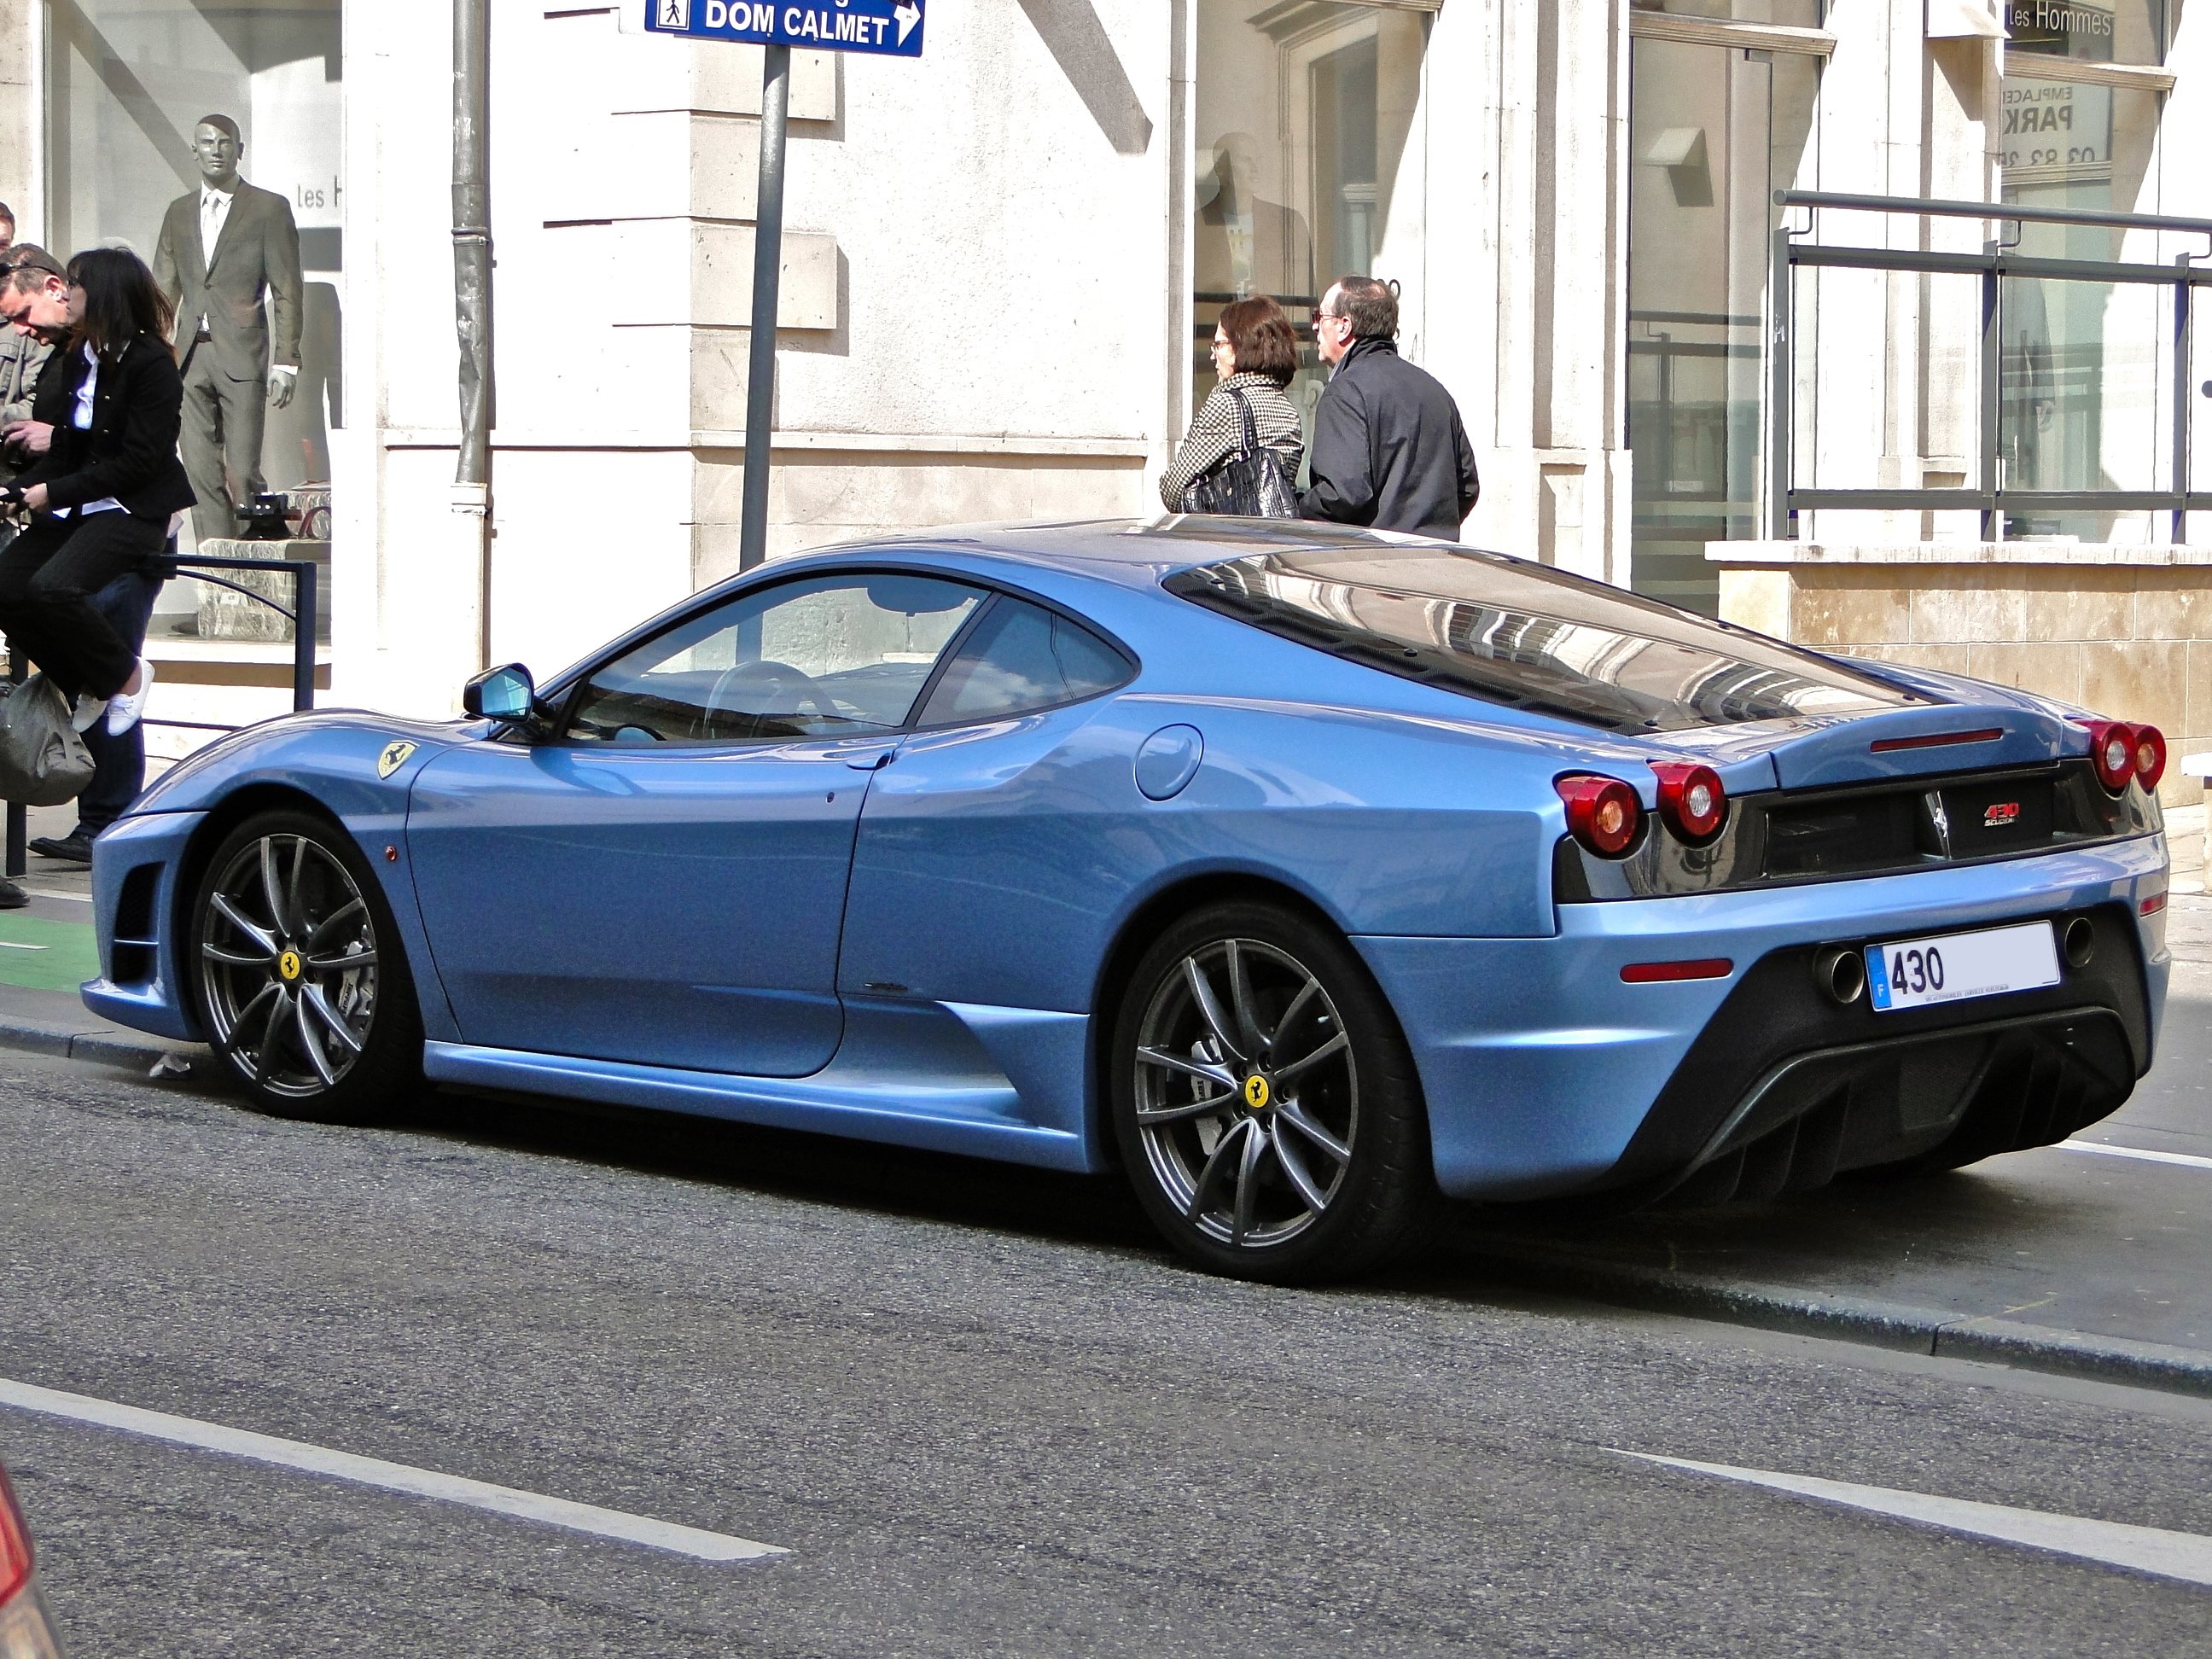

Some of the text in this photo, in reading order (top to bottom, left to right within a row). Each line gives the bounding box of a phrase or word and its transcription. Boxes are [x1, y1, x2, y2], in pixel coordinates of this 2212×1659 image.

[706, 0, 890, 45] DOM CALMET
[2036, 0, 2111, 36] Hommes
[297, 183, 324, 208] les
[1984, 802, 2020, 819] 430
[1892, 946, 1944, 994] 430
[1877, 983, 1884, 997] F
